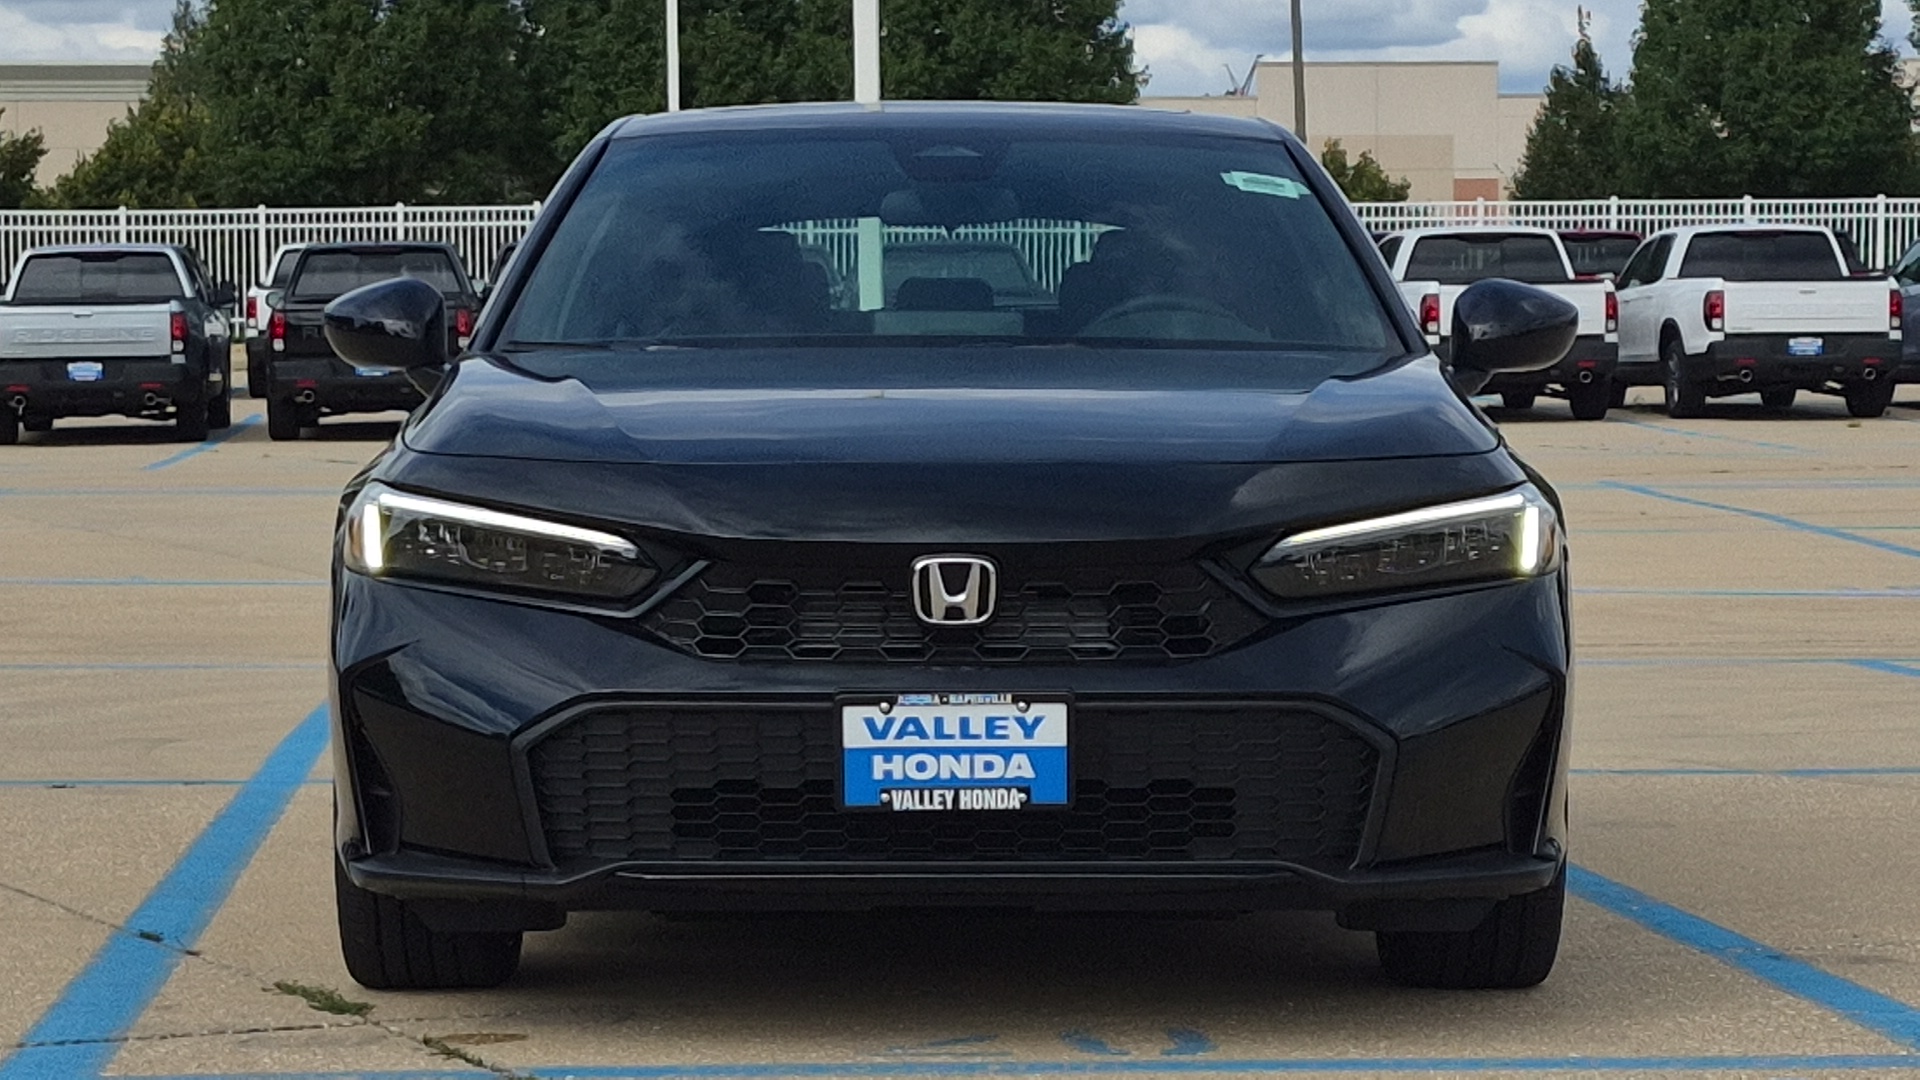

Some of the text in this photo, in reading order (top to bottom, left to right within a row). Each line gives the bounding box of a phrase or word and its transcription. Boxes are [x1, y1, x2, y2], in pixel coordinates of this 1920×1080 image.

[863, 715, 1046, 741] VALLEY
[872, 752, 1036, 780] HONDA
[890, 788, 1021, 811] VALLEY HONDA
